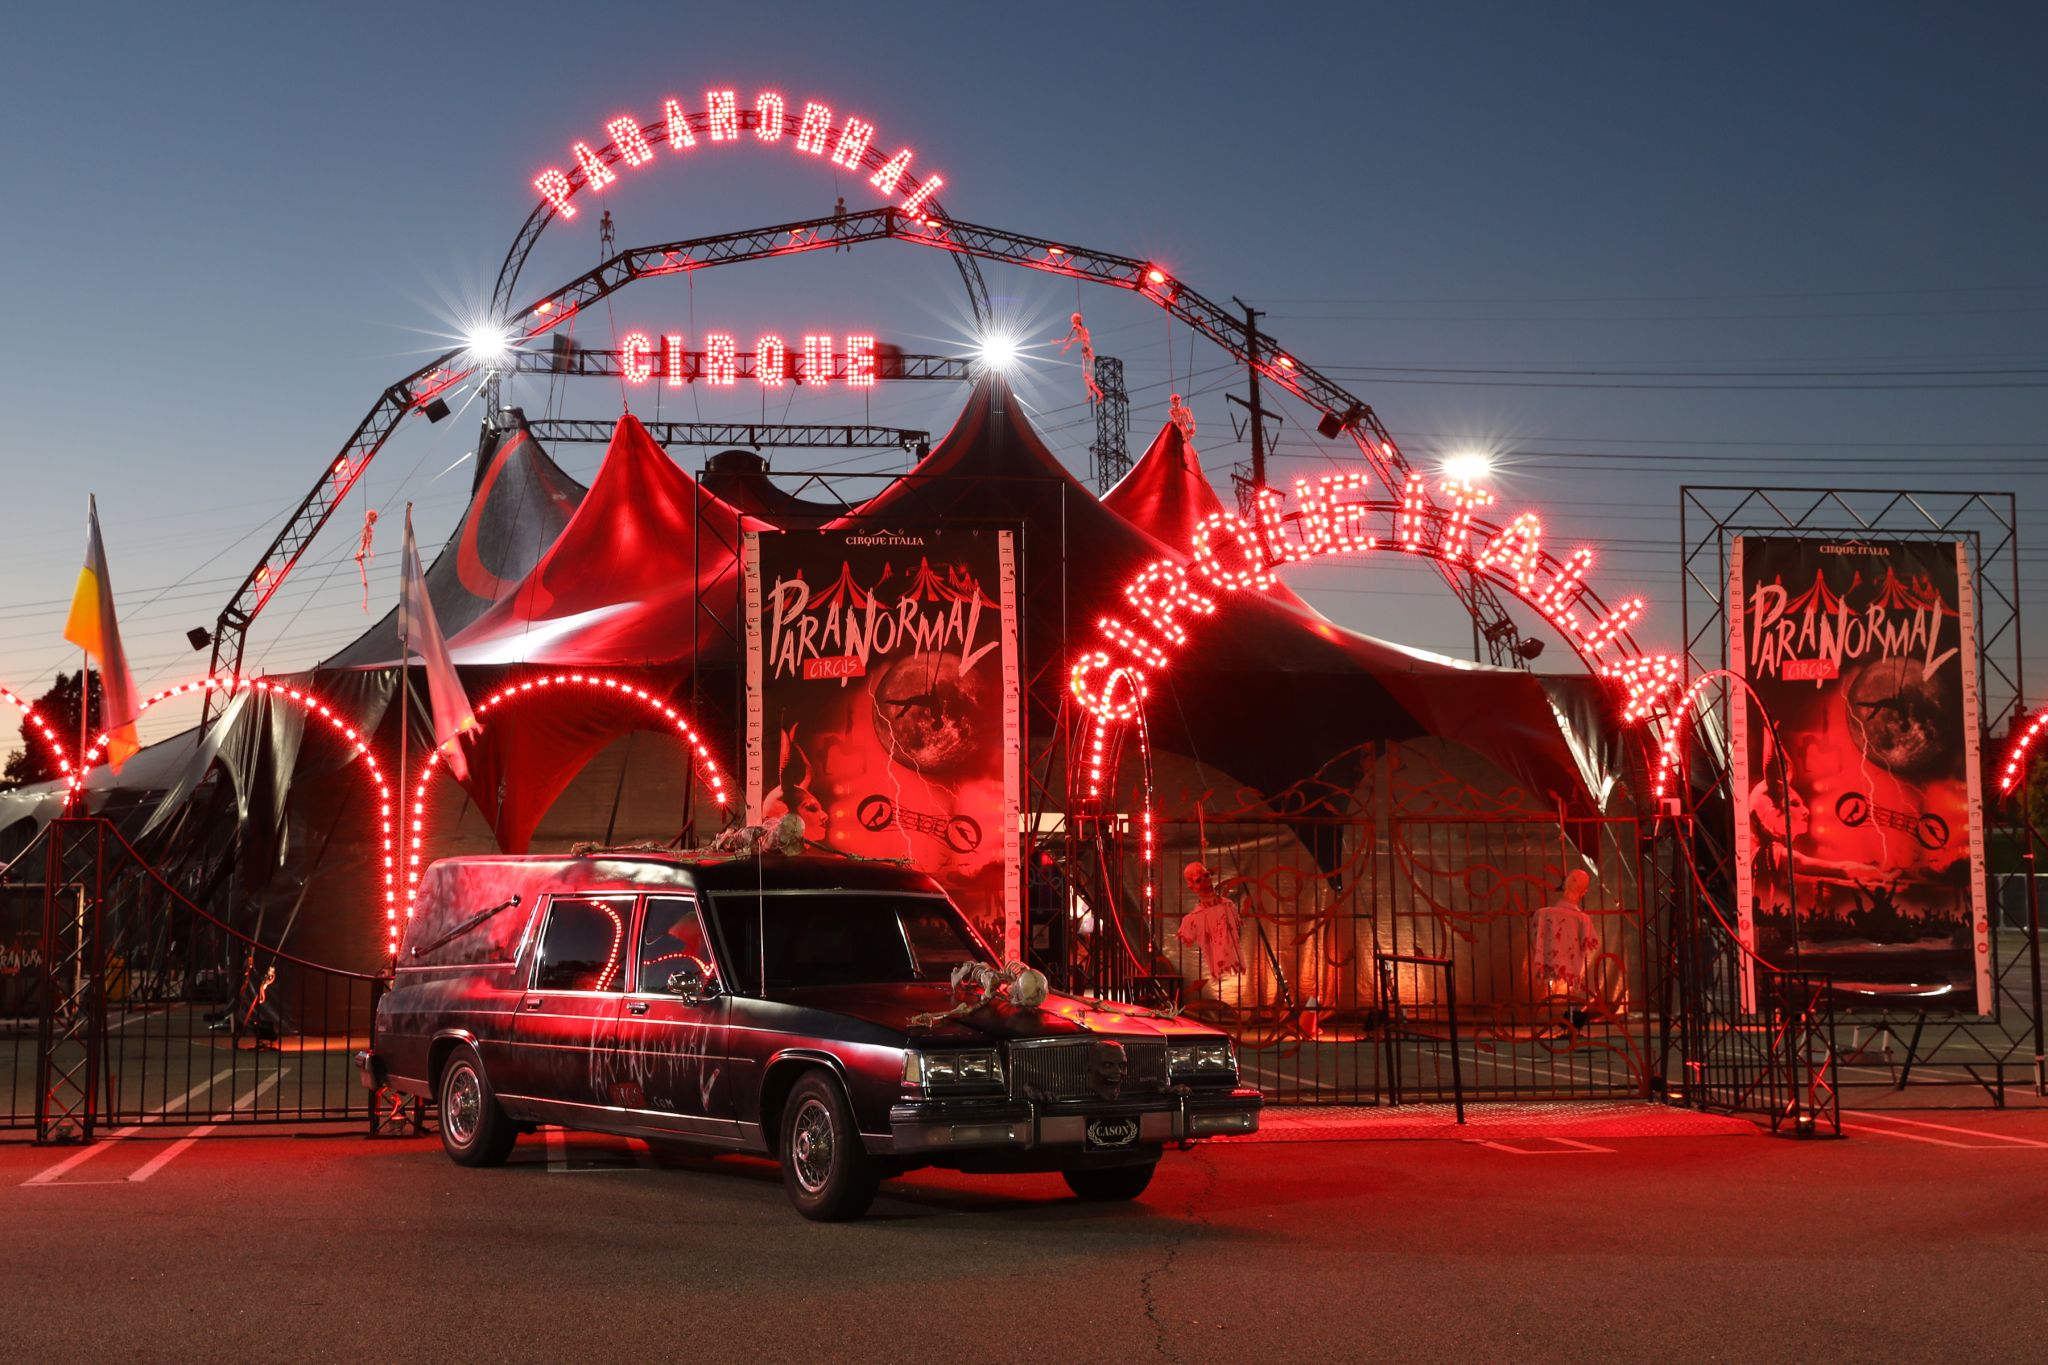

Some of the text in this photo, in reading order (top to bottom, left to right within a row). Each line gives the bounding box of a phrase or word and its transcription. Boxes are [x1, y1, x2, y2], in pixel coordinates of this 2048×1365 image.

[534, 90, 944, 225] PARANORMAL
[622, 332, 875, 387] CIRQUE
[845, 536, 924, 547] CIRQUE ITALIA
[1820, 545, 1891, 557] CIRQUE ITALIA
[768, 575, 1000, 688] PARANORMAL
[1070, 472, 1680, 723] CIRQUE ITALIA
[1750, 579, 1959, 689] PARANORMAL
[1096, 1125, 1130, 1137] CASON
